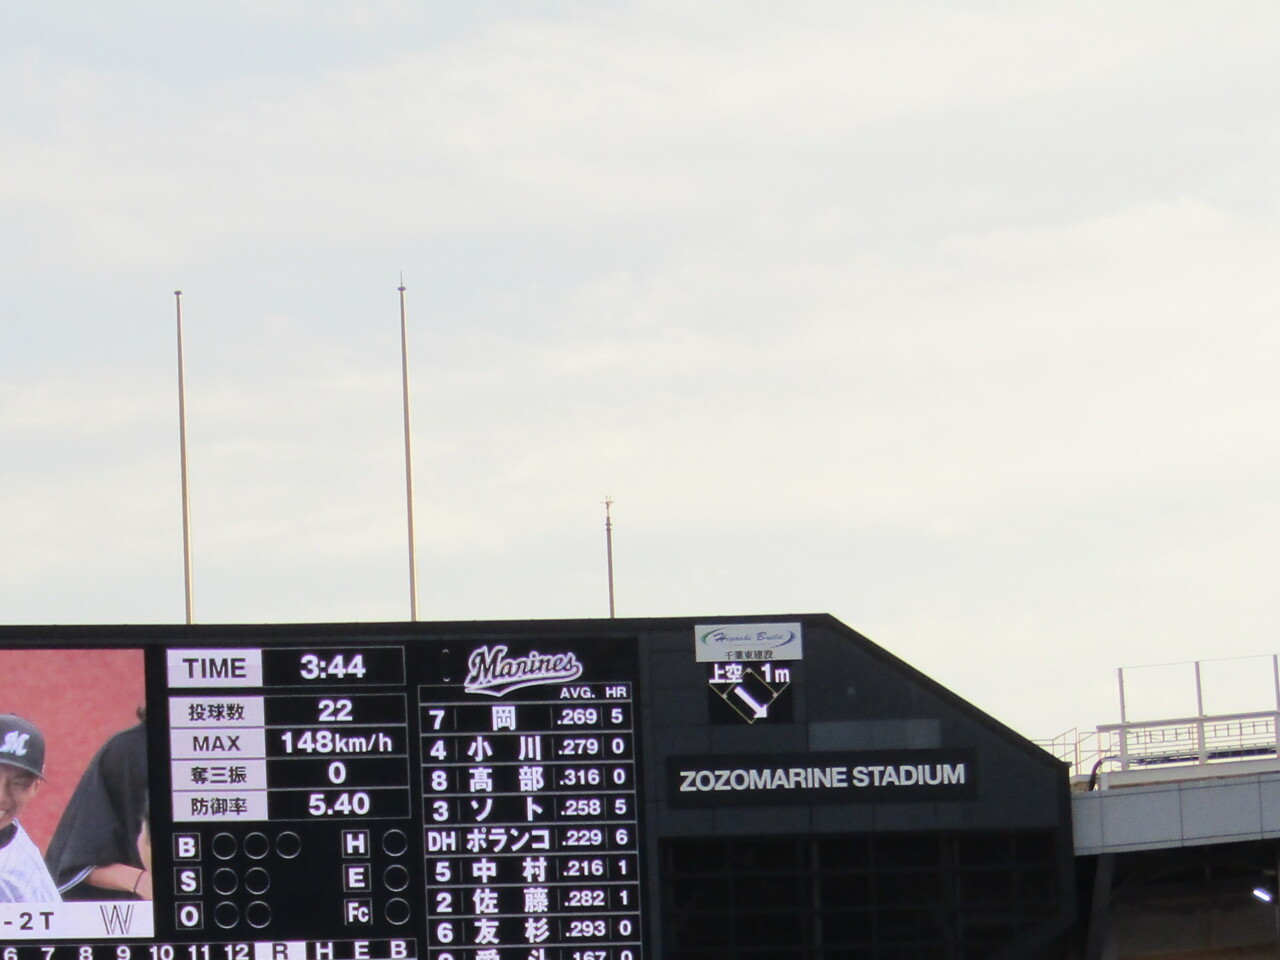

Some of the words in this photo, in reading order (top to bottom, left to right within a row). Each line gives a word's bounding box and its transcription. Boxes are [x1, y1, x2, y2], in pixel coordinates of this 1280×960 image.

[182, 657, 247, 679] TIME
[300, 654, 367, 680] 3:44
[464, 645, 582, 697] Marines
[708, 662, 743, 684] 上空
[559, 686, 596, 699] AVG.
[605, 686, 627, 698] HR
[188, 703, 245, 722] 投球数
[318, 699, 353, 722] 22
[491, 705, 516, 732] 岡
[557, 708, 598, 725] .269
[192, 735, 241, 752] MAX
[281, 730, 392, 754] 148km/h
[558, 738, 599, 755] .279
[191, 765, 247, 785] 奪三振
[328, 761, 347, 784] 0
[559, 768, 600, 786] .316
[679, 766, 848, 792] ZOZOMARINE
[852, 763, 965, 788] STADIUM
[190, 797, 248, 816] 防御率
[308, 792, 370, 816] 5.40
[560, 798, 601, 816] .258
[178, 837, 196, 858] B
[346, 833, 365, 854] H
[427, 831, 456, 852] DH
[466, 826, 550, 853] ポランコ
[562, 829, 603, 846] .229
[563, 859, 604, 876] .216
[180, 870, 197, 892] S
[348, 867, 366, 888] E
[564, 890, 605, 907] .282
[565, 920, 606, 937] .293
[271, 943, 289, 960] R
[315, 941, 334, 959] H
[354, 941, 370, 959] E
[390, 940, 408, 958] B
